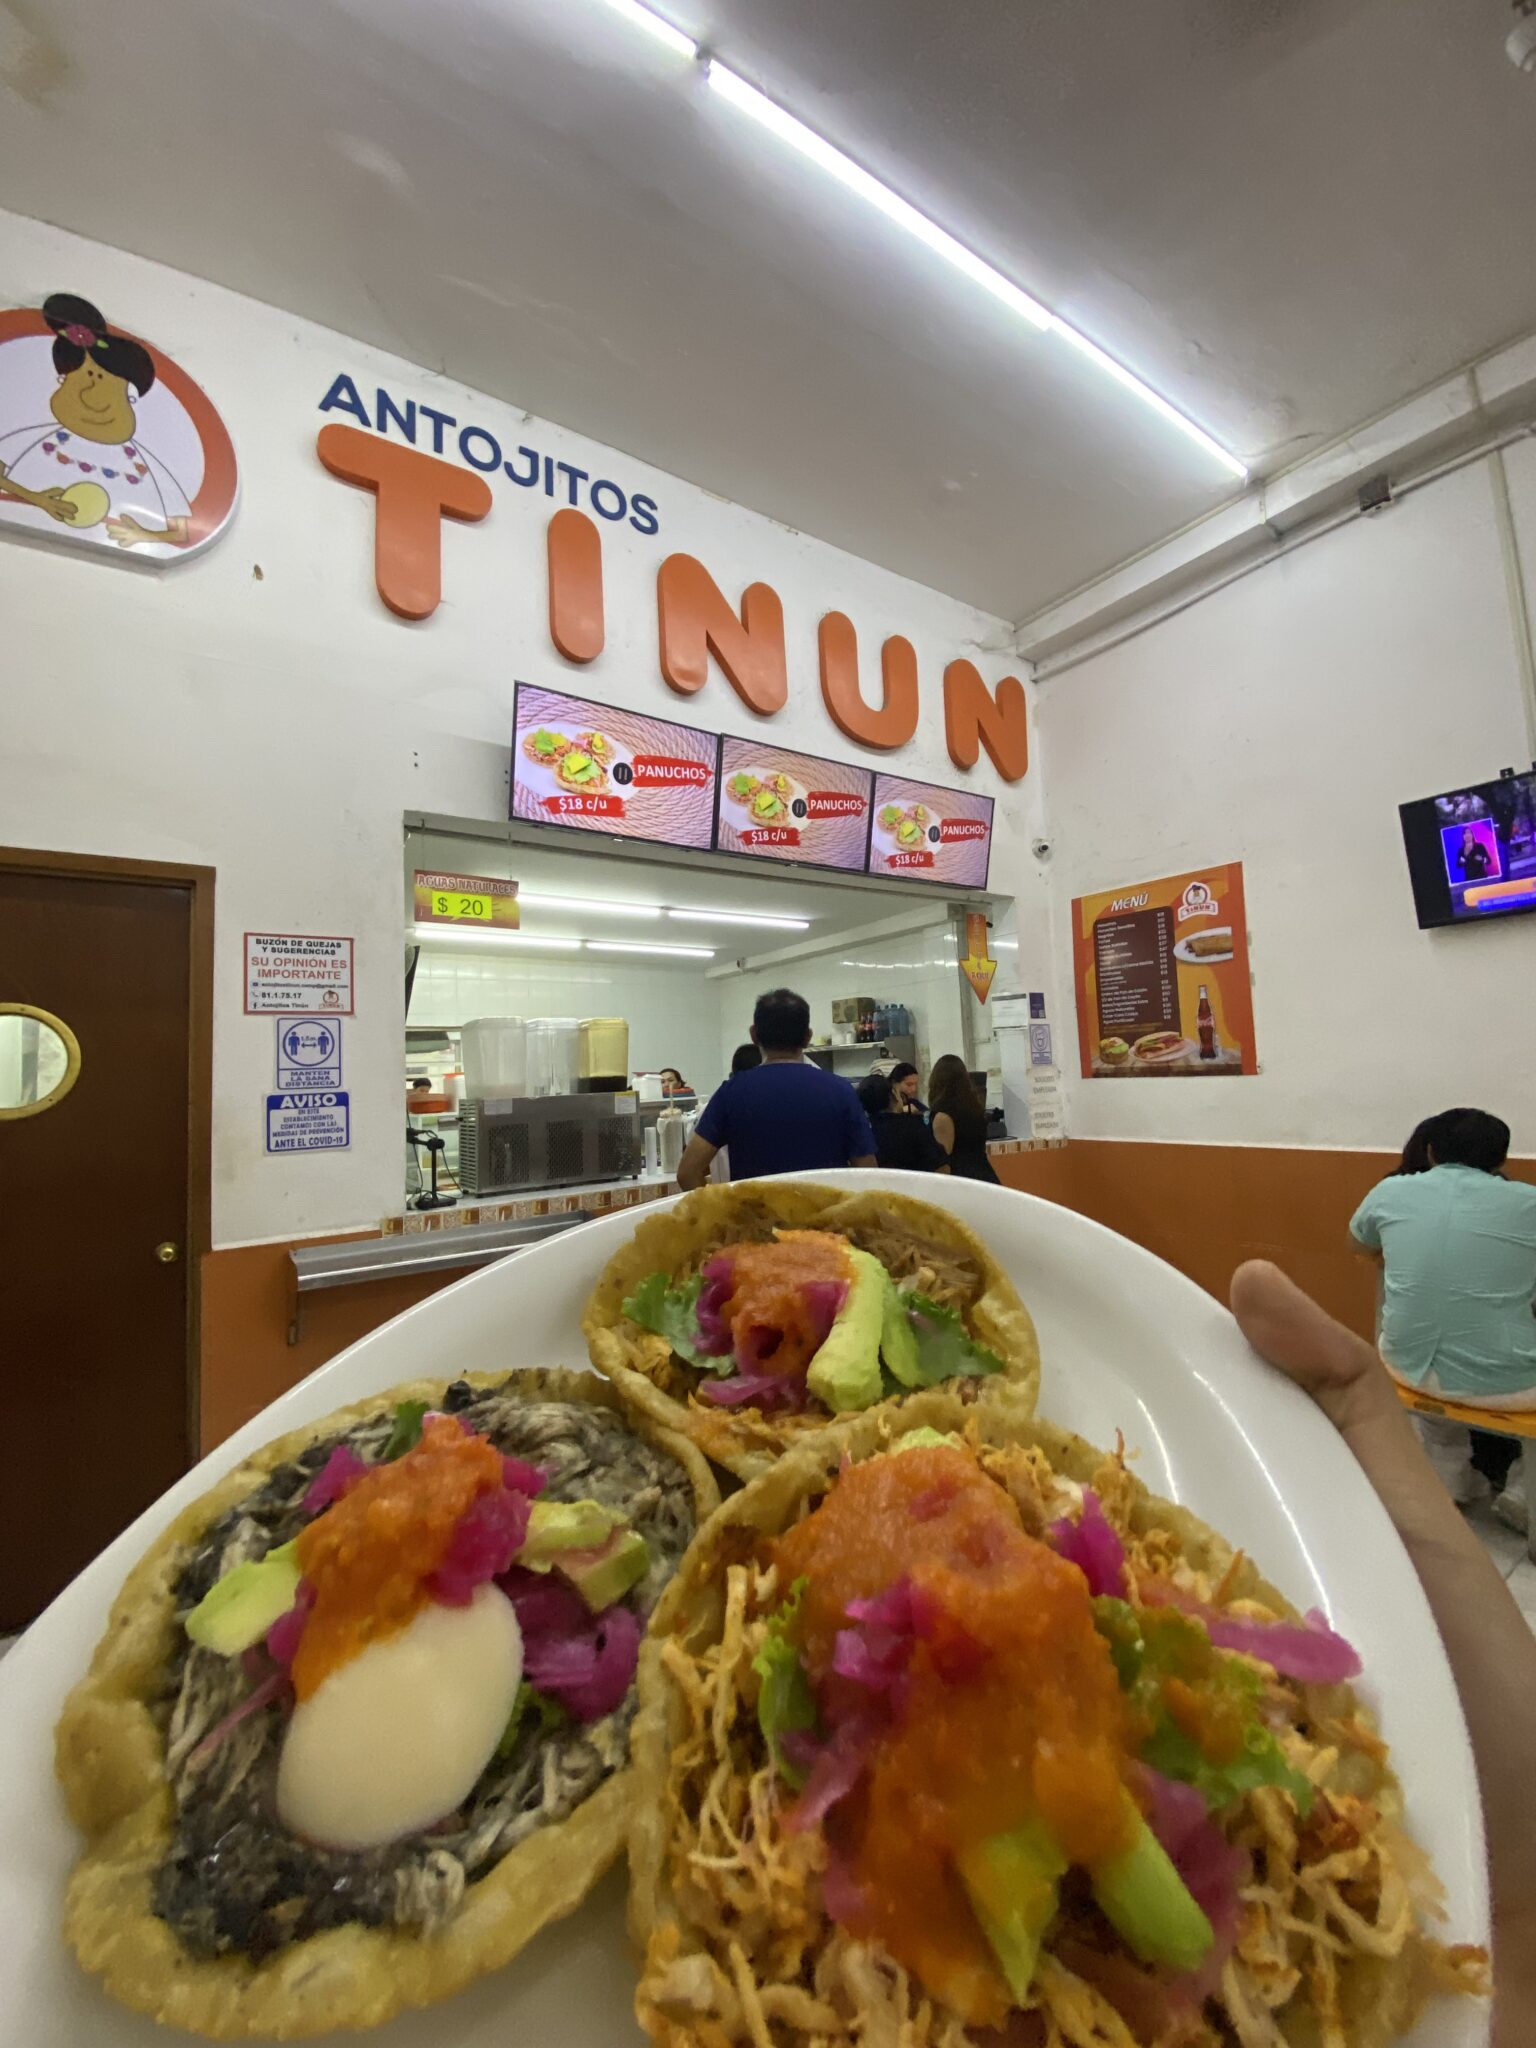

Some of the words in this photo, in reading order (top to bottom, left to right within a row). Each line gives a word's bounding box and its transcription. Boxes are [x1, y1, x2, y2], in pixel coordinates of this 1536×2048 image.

[318, 373, 660, 536] ANTOJITOS
[316, 421, 1029, 783] TINUN
[637, 764, 706, 780] PANUCHOS
[559, 798, 582, 812] $18
[586, 796, 608, 812] c/u
[810, 799, 863, 811] PANUCHOS
[751, 830, 769, 844] $18
[771, 829, 787, 843] c/u
[943, 824, 985, 836] PANUCHOS
[895, 854, 910, 866] $18
[911, 853, 924, 865] c/u
[416, 873, 456, 890] AGUAS
[438, 896, 448, 913] $
[460, 898, 484, 916] 20
[1111, 891, 1149, 912] MENÚ
[256, 937, 288, 946] BUZÓN
[306, 940, 342, 949] QUEJAS
[271, 947, 336, 956] SUGERENCIAS
[251, 956, 269, 967] SU
[273, 957, 327, 969] OPINIÓN
[331, 959, 347, 969] ES
[257, 968, 342, 980] IMPORTANTE
[280, 1093, 337, 1109] AVISO
[274, 1138, 295, 1149] ANTE
[297, 1138, 306, 1146] EL
[308, 1135, 343, 1146] COVID-19
